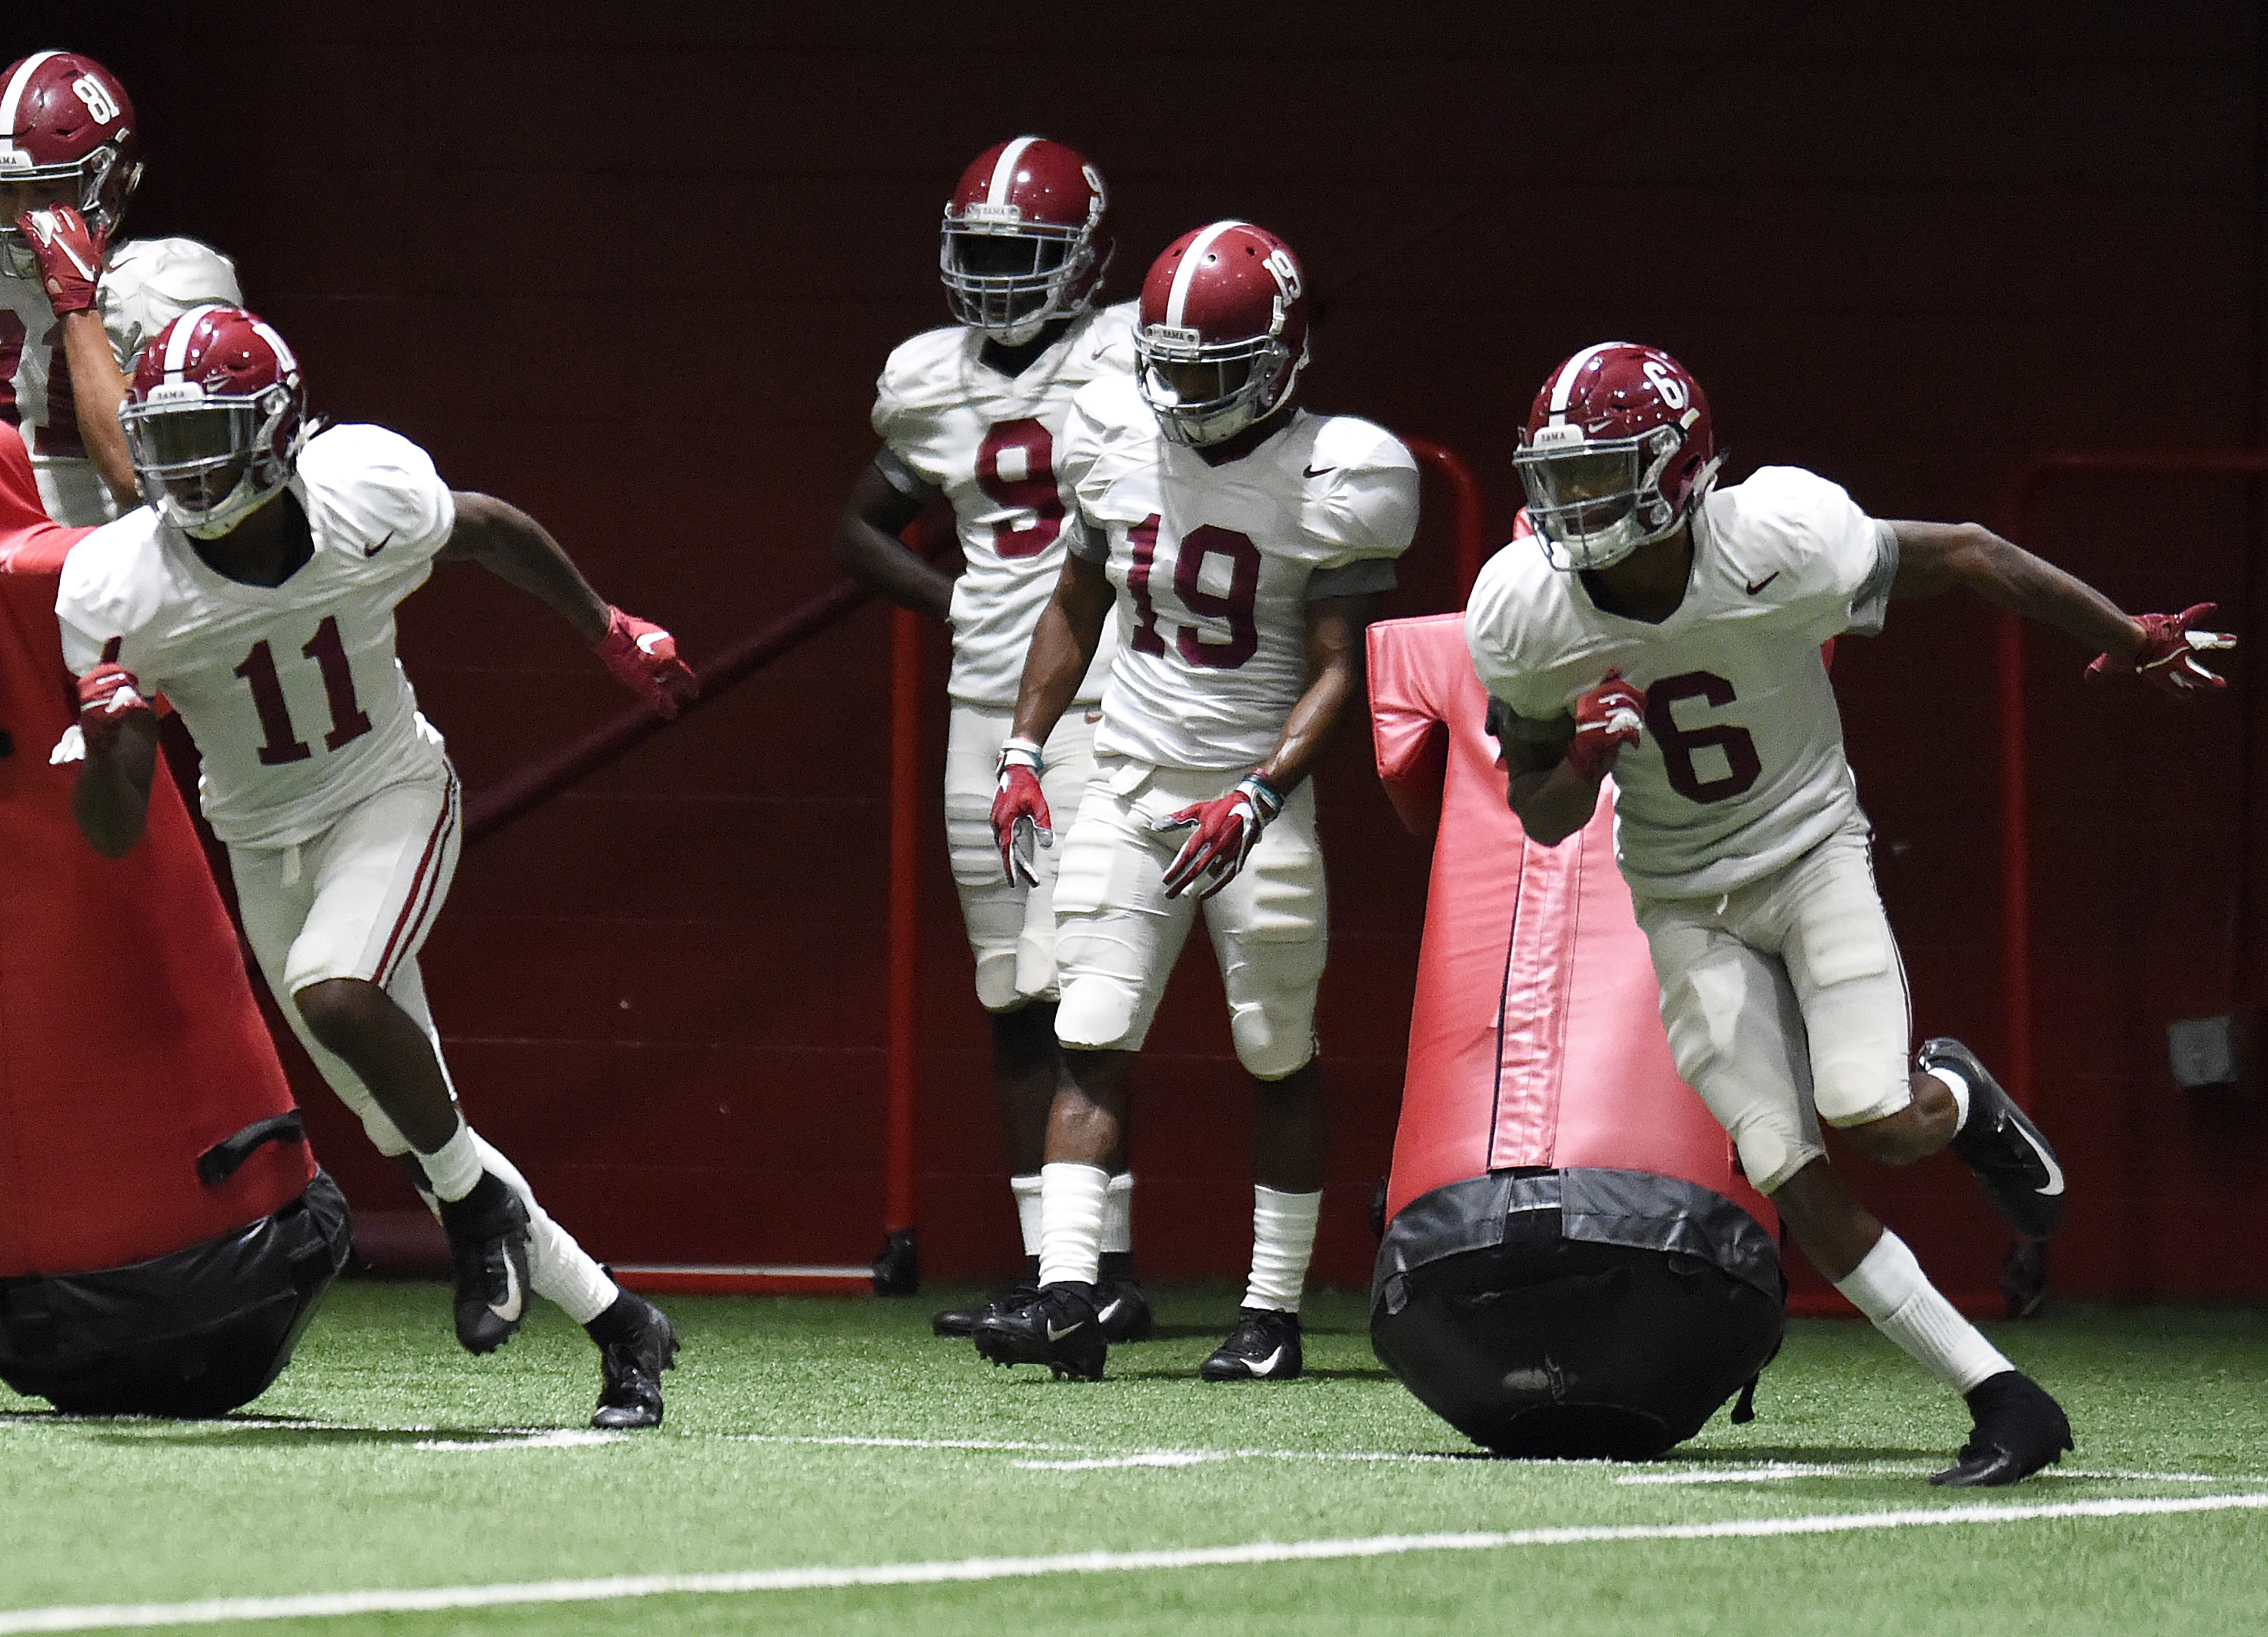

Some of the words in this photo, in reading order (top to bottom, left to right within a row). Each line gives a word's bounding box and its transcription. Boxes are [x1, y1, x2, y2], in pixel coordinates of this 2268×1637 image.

[72, 73, 120, 125] 81
[1262, 250, 1301, 308] 19
[1162, 329, 1185, 340] BAMA
[1643, 361, 1684, 409] 6
[974, 418, 1066, 558] 9
[1127, 513, 1261, 669] 19
[232, 615, 373, 765] 11
[1644, 671, 1762, 804] 6
